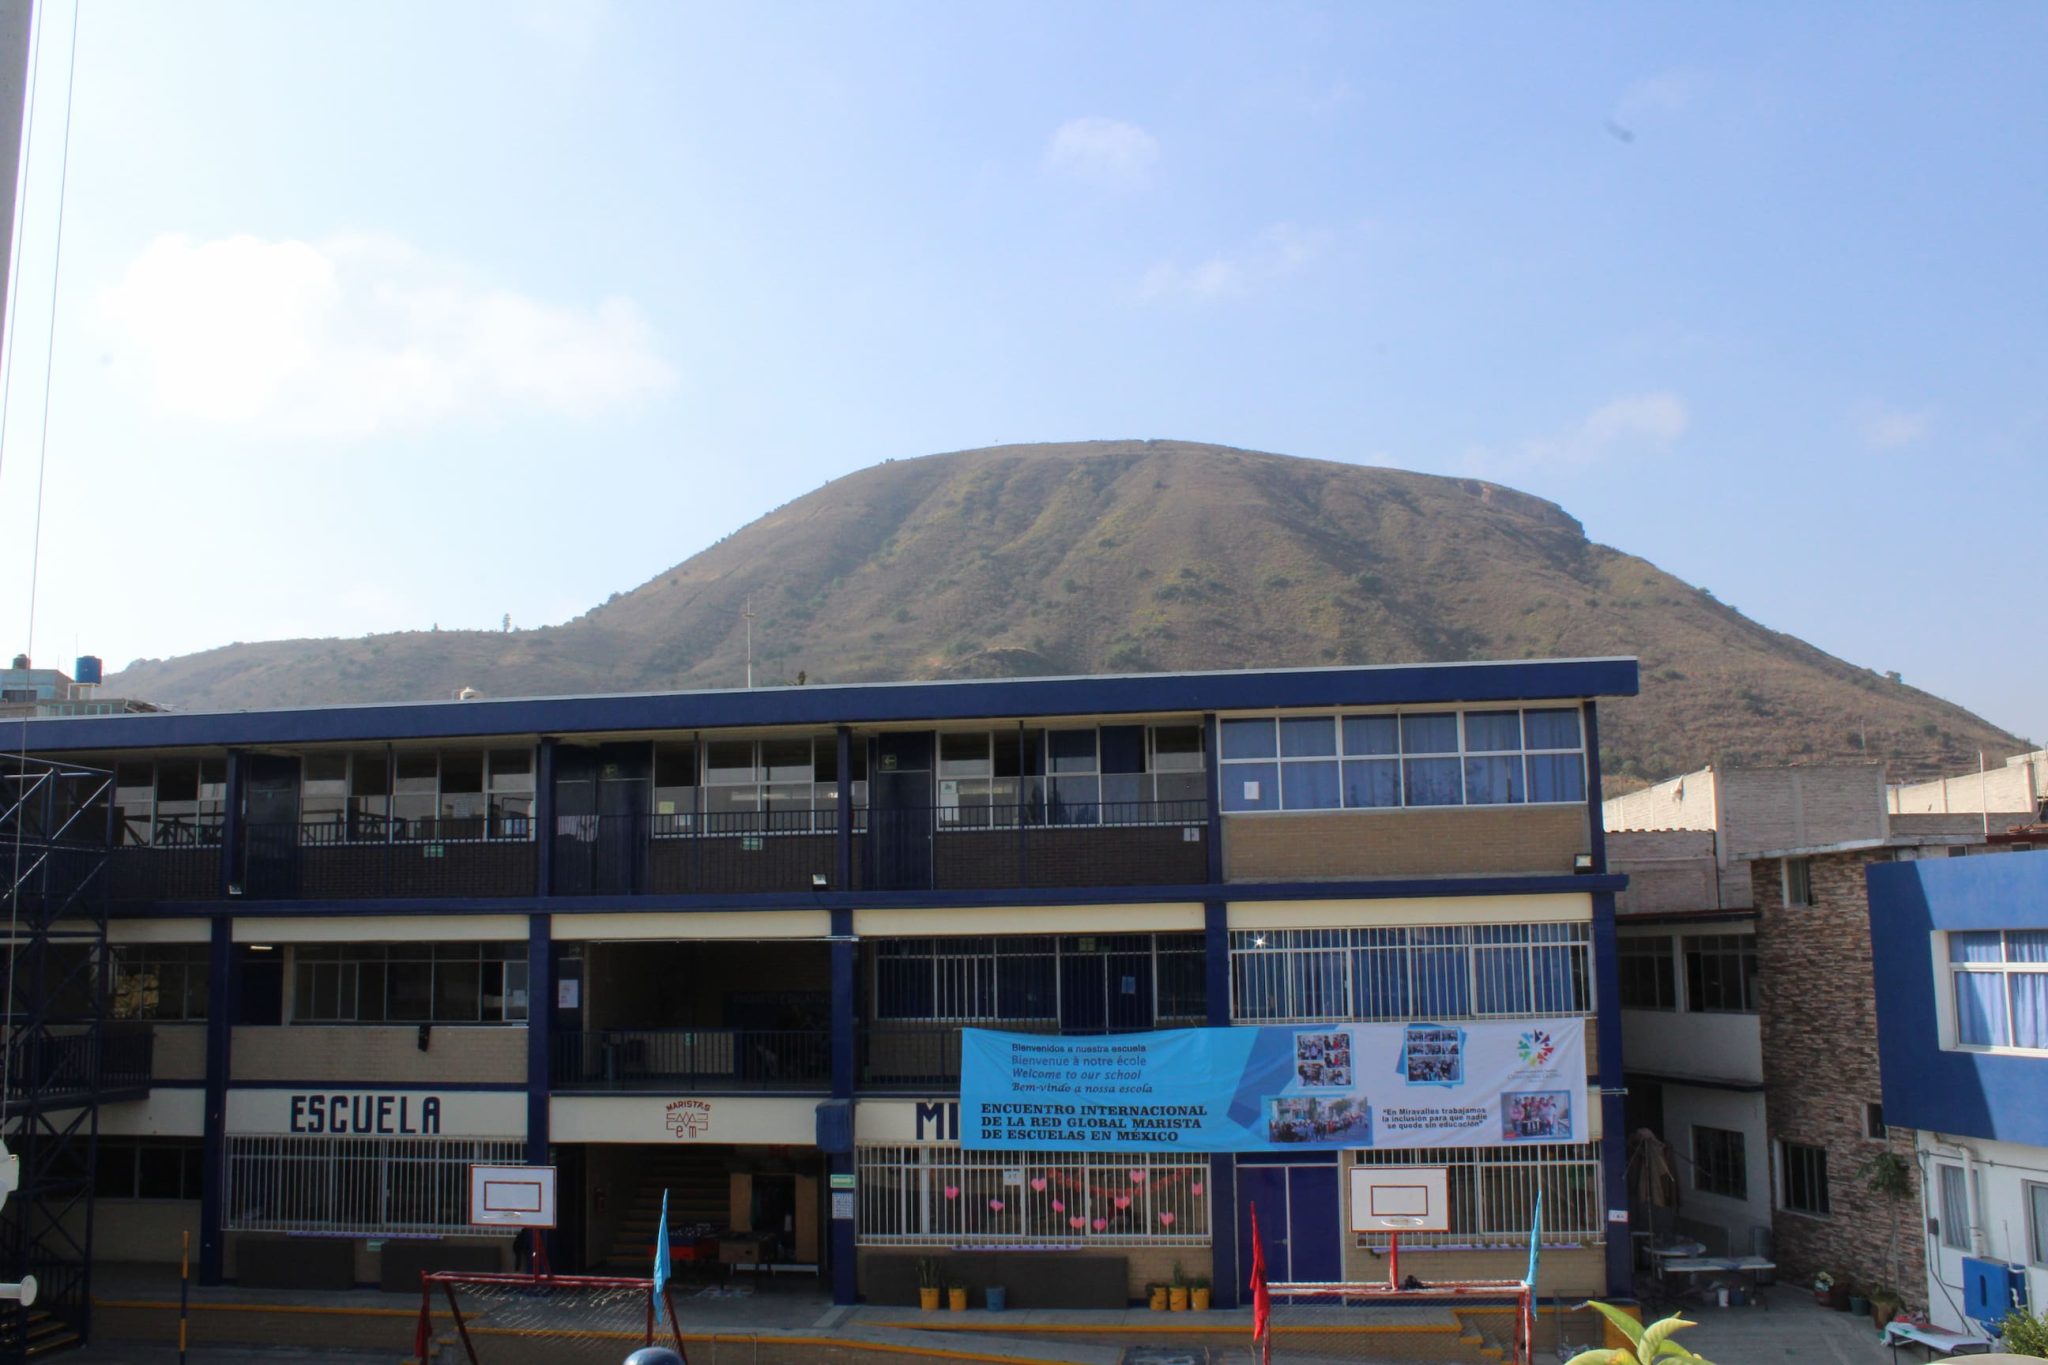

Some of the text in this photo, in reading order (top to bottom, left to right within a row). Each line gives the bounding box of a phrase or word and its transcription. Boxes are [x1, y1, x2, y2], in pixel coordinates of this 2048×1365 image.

[1012, 1043, 1065, 1053] Bienvenidos
[1111, 1044, 1146, 1053] escuela
[1012, 1055, 1070, 1066] Bienvenue
[1083, 1057, 1113, 1066] notre
[1117, 1055, 1147, 1066] école
[1013, 1068, 1141, 1080] Welcome to our school
[1012, 1082, 1071, 1093] Bem-vindo
[1075, 1086, 1082, 1095] a
[1119, 1083, 1153, 1093] escola
[666, 1100, 711, 1112] MARISTAS
[981, 1103, 1208, 1116] ENCUENTRO INTERNACIONAL
[1442, 1107, 1487, 1115] trabajamos
[291, 1095, 441, 1134] ESCUELA
[1449, 1114, 1464, 1122] que
[1466, 1113, 1488, 1121] nadie
[981, 1116, 1202, 1129] DE LA RED GLOBAL MARISTA
[1399, 1121, 1423, 1130] quede
[1425, 1121, 1437, 1129] sin
[981, 1128, 1178, 1142] DE ESCUELAS EN MÉXICO
